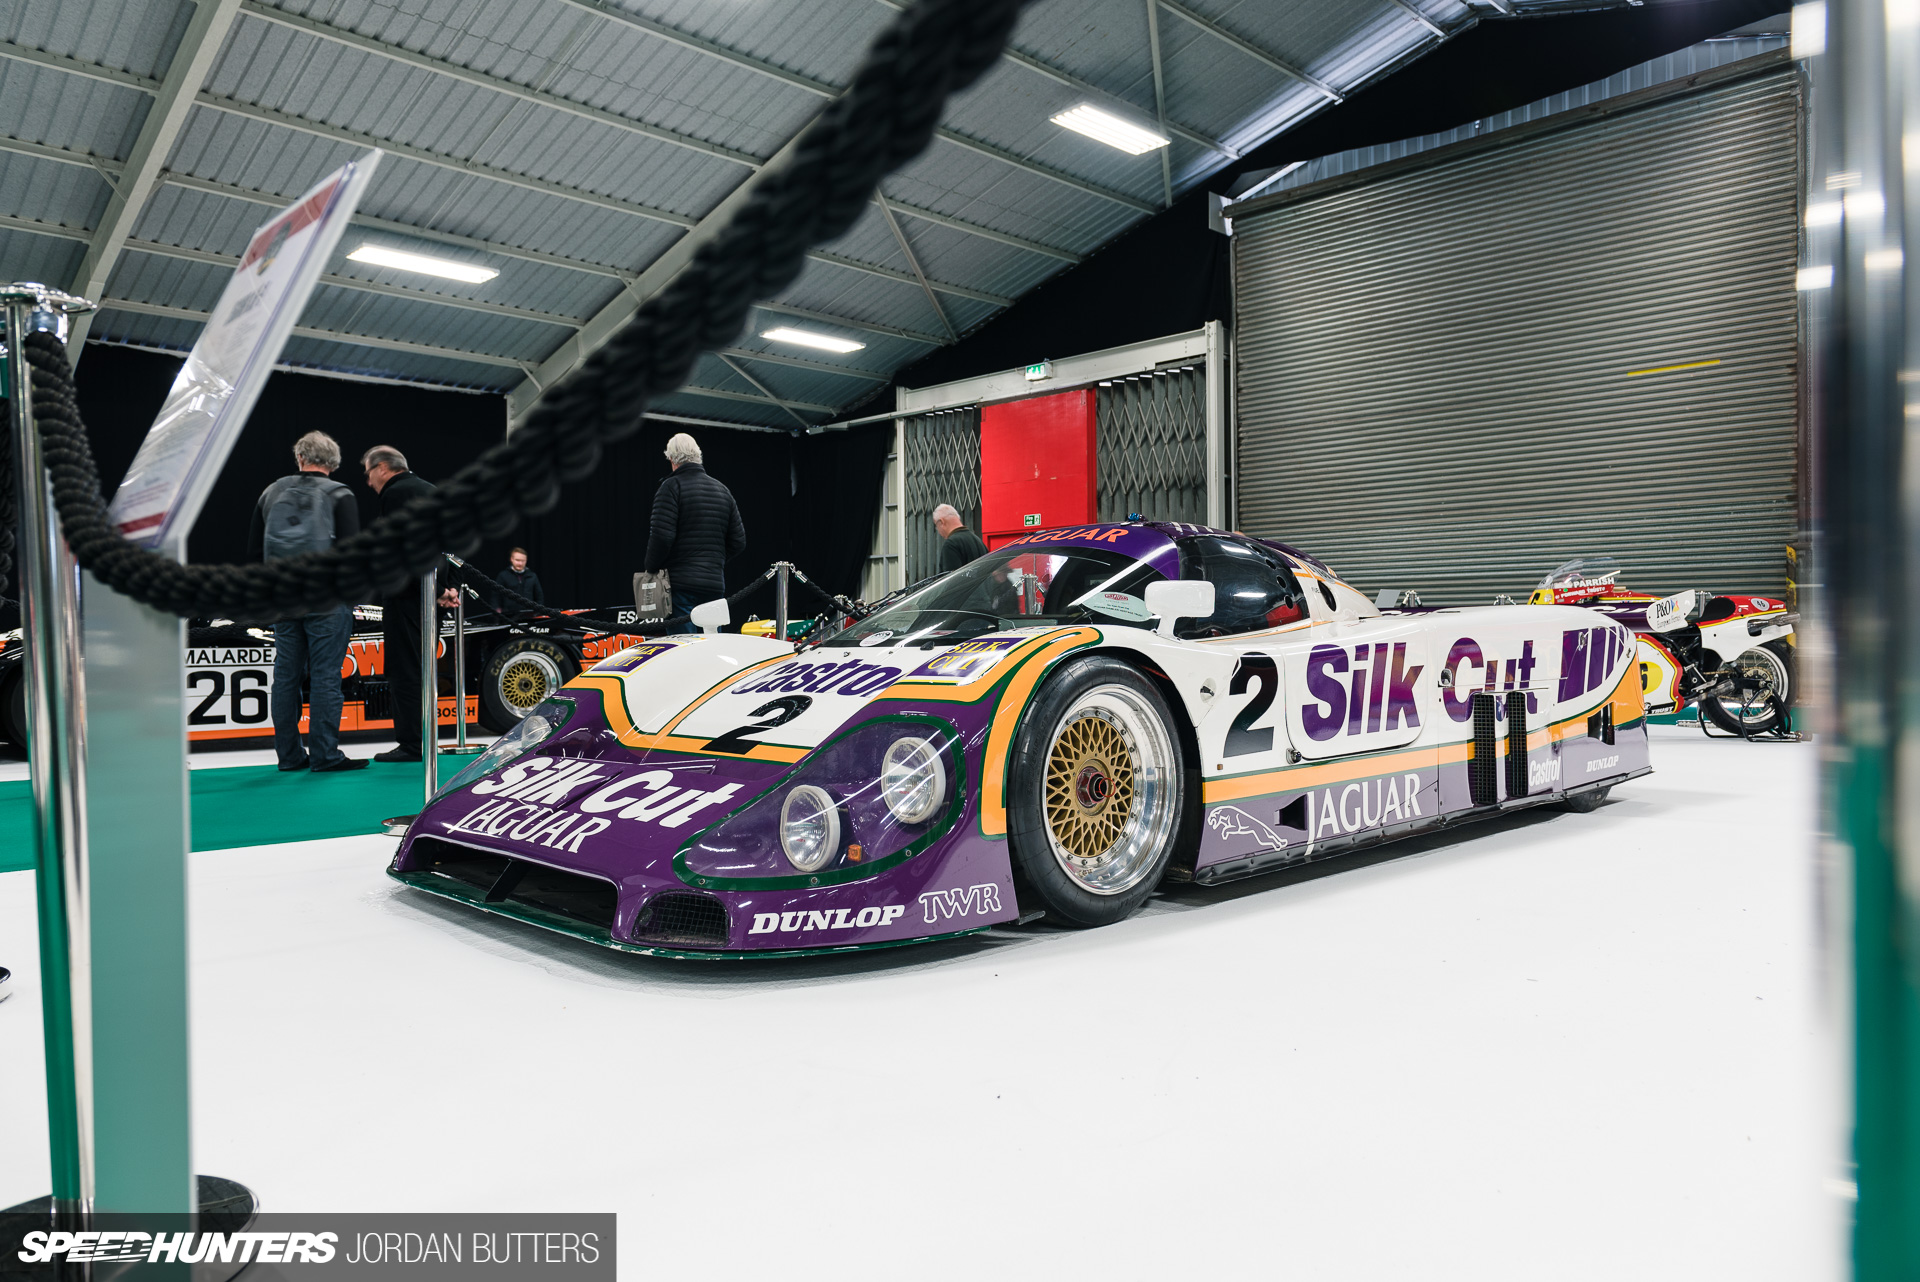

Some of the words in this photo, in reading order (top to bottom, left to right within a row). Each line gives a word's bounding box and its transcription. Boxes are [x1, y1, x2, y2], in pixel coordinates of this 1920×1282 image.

[1002, 528, 1129, 548] AGUAR
[1573, 577, 1615, 588] PARRISH
[1656, 600, 1671, 619] P&O
[509, 626, 550, 634] GOOYEAR
[184, 649, 276, 665] MALARDE
[490, 640, 564, 677] GOOYEAR
[927, 655, 982, 670] CUT
[946, 641, 1010, 654] SILK
[187, 669, 268, 726] 26
[1223, 651, 1278, 758] 2
[1302, 642, 1425, 742] Silk
[1443, 637, 1538, 723] Cut
[437, 706, 475, 718] BOSH
[699, 694, 813, 755] 2
[1529, 756, 1561, 787] Castrol
[1586, 755, 1619, 773] DUNLOP
[471, 757, 605, 804] Silk
[580, 770, 745, 828] Cut
[447, 799, 612, 853] JAGUAR
[1304, 773, 1422, 856] JAGUAR
[919, 883, 1002, 923] TWR
[748, 905, 905, 934] DUNLOP
